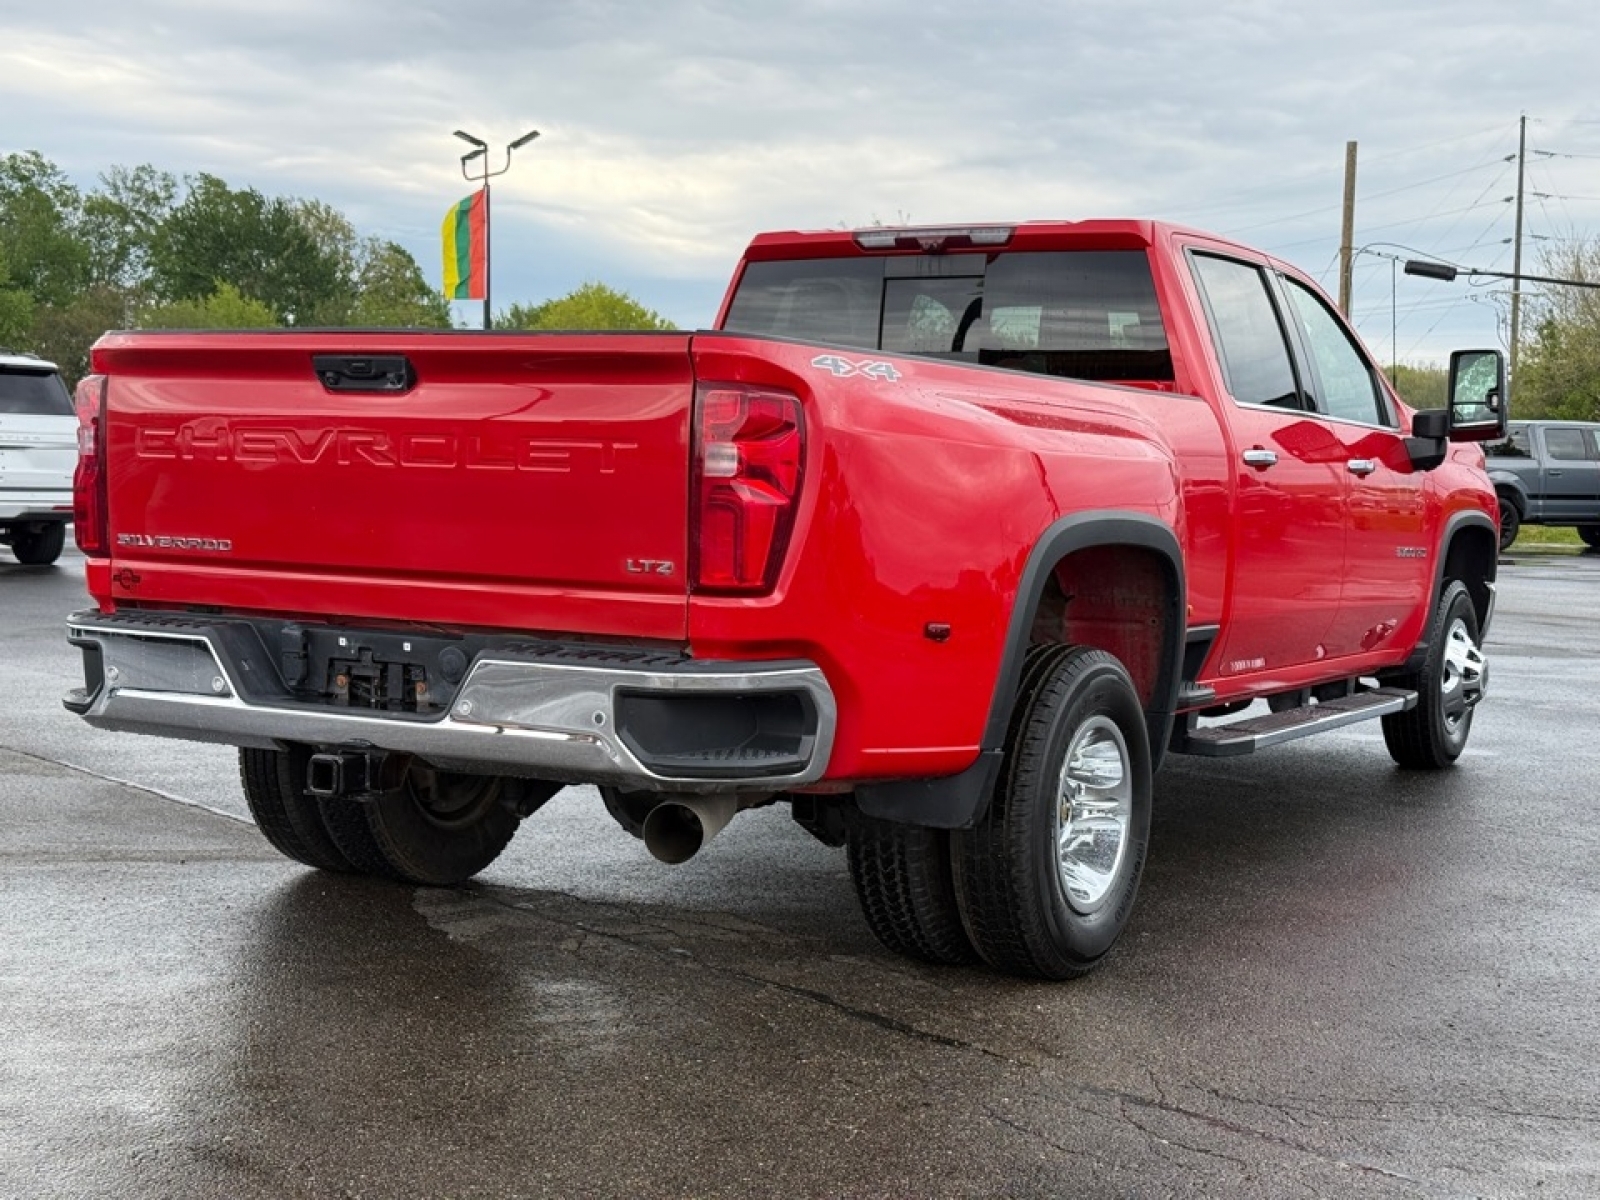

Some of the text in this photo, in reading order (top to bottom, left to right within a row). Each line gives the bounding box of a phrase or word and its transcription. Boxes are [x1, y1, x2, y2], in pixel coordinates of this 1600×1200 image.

[135, 426, 638, 474] CHEVROLET
[117, 533, 231, 551] SILVERADO
[626, 558, 674, 575] LTZ
